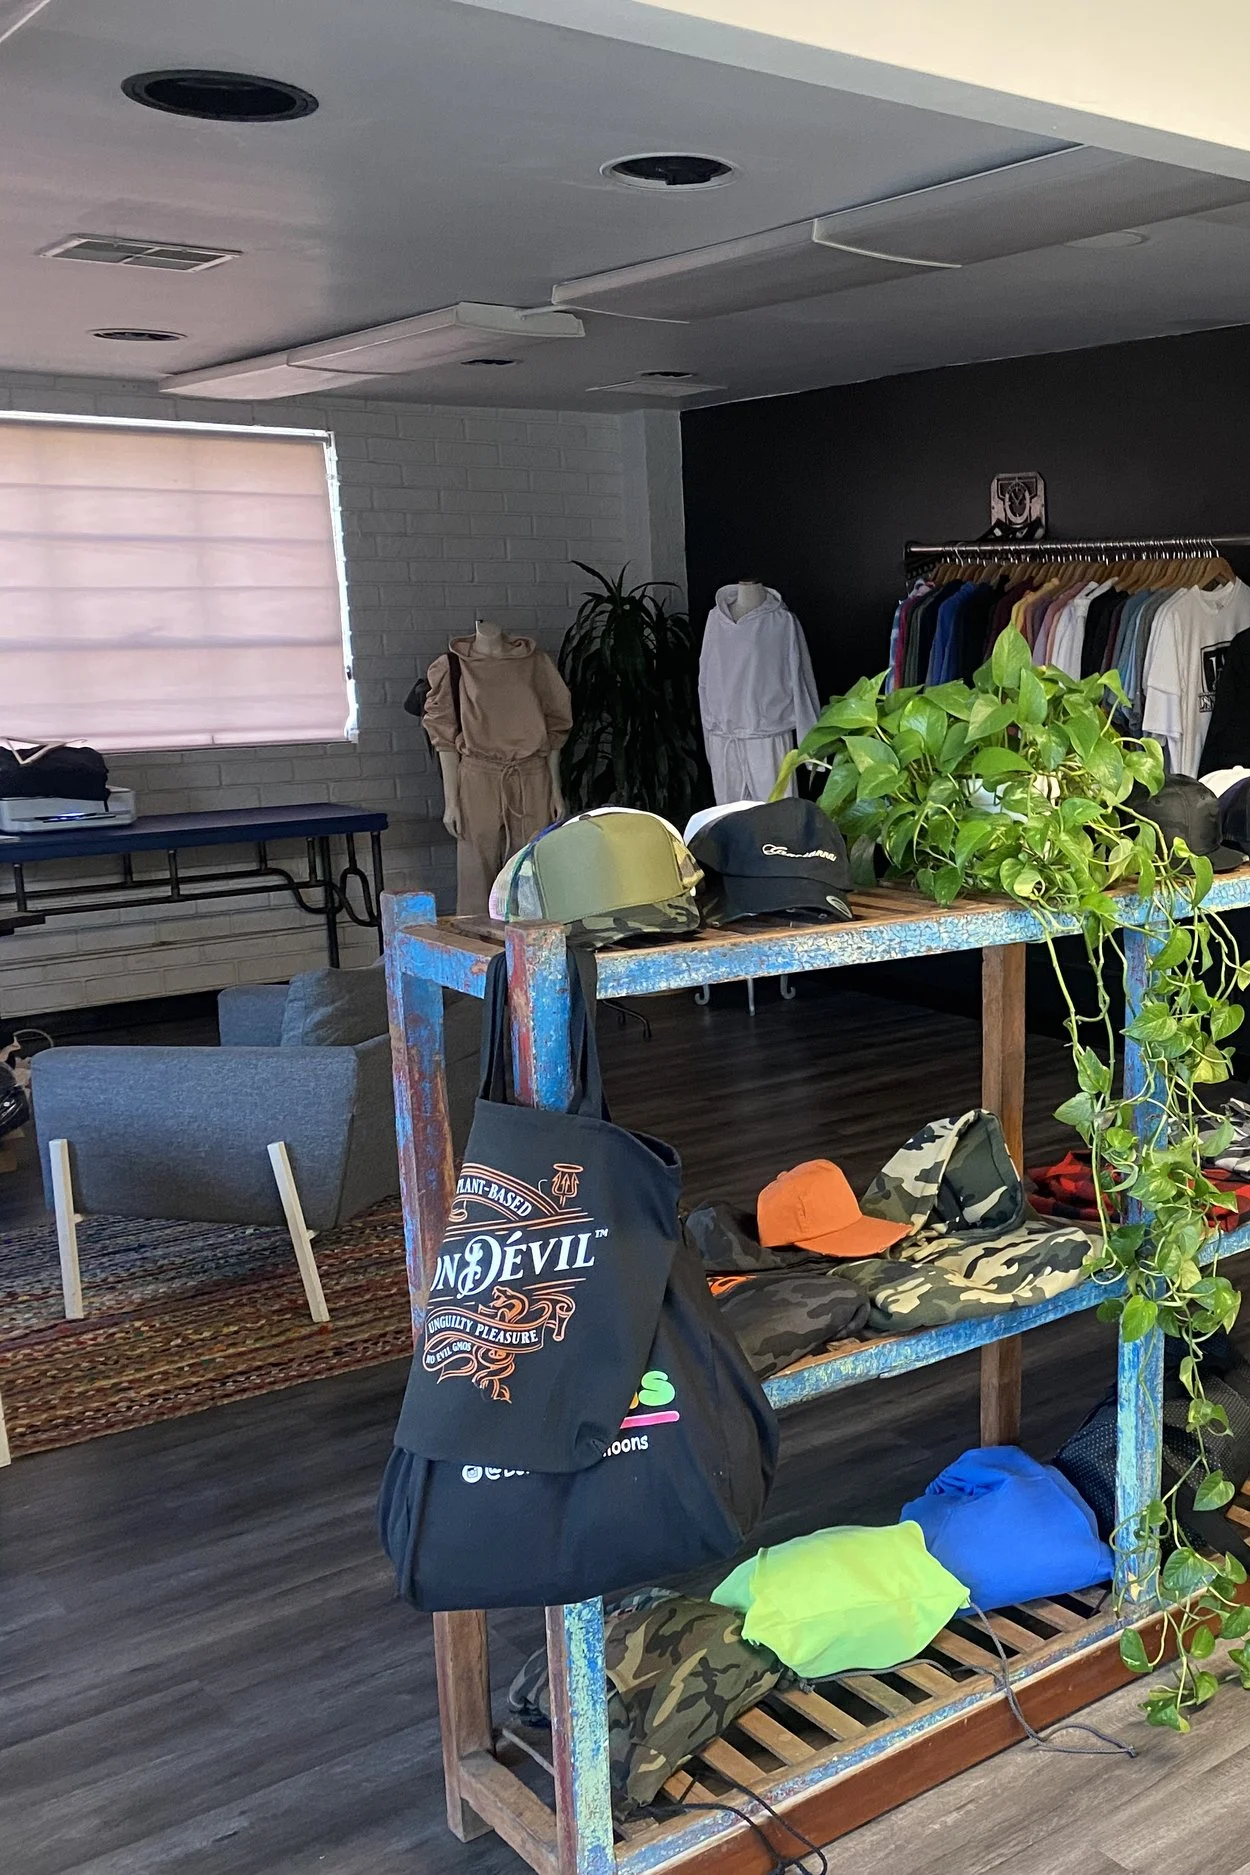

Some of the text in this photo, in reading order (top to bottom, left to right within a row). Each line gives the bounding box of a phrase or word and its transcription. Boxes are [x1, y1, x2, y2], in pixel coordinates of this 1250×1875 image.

[427, 1314, 539, 1345] UNGUILTY PLEASURE
[436, 1349, 453, 1363] EVIL
